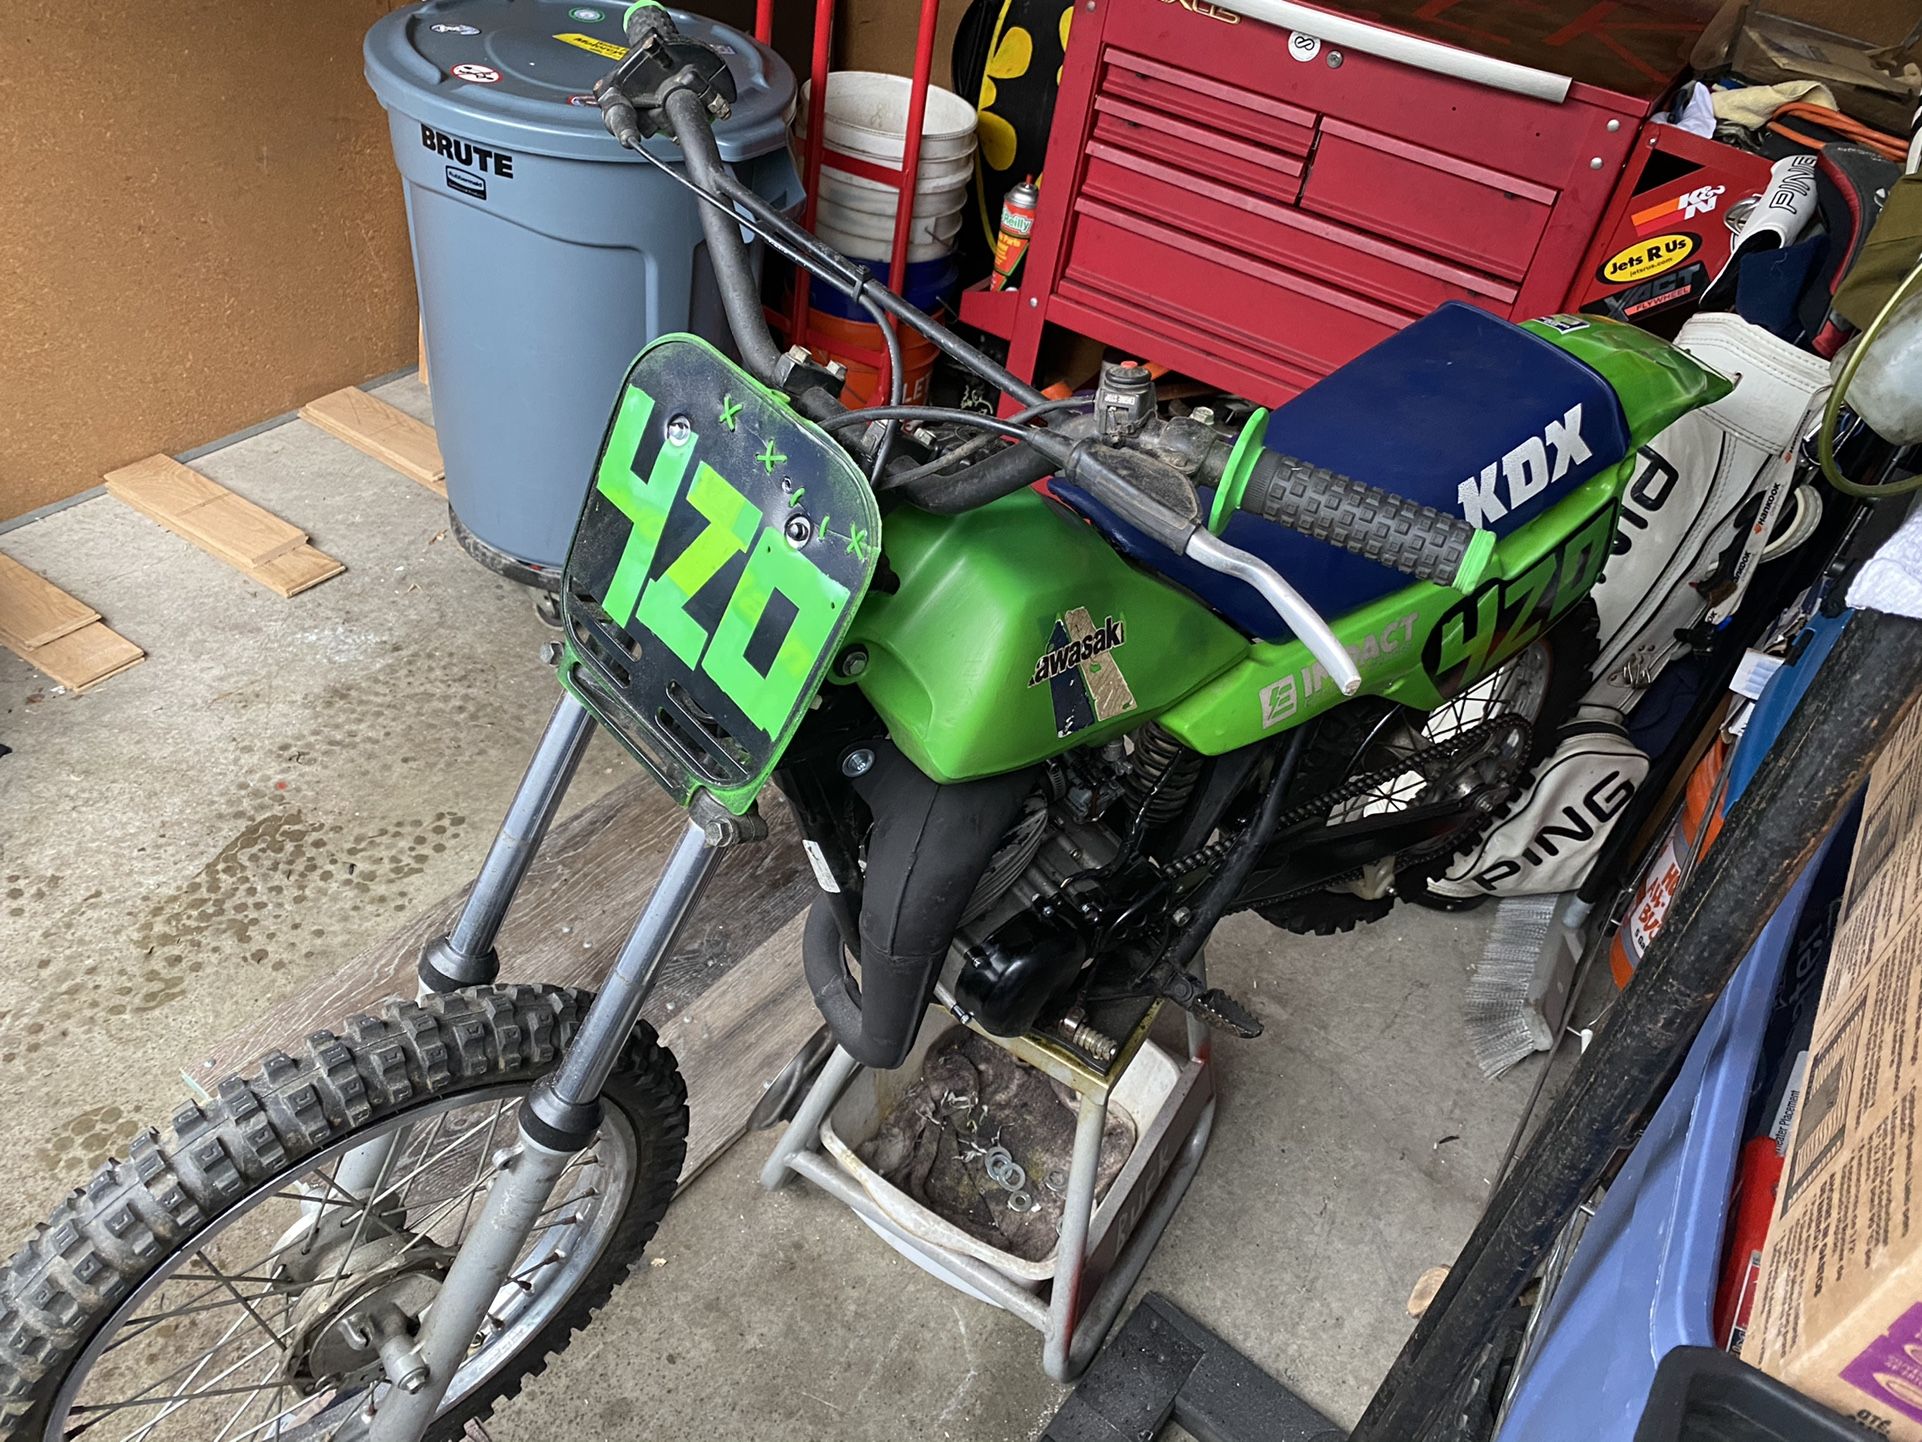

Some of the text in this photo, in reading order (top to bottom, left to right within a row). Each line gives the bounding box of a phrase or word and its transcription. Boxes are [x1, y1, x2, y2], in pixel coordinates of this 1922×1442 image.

[421, 122, 513, 179] BRUTE
[1678, 185, 1726, 220] K&N
[1610, 238, 1688, 275] Jets R Us
[1604, 263, 1700, 321] XACT
[1636, 287, 1689, 311] FLYWHEEL
[1457, 403, 1593, 529] KDX
[1472, 770, 1635, 891] PING
[1780, 1089, 1801, 1127] Placement
